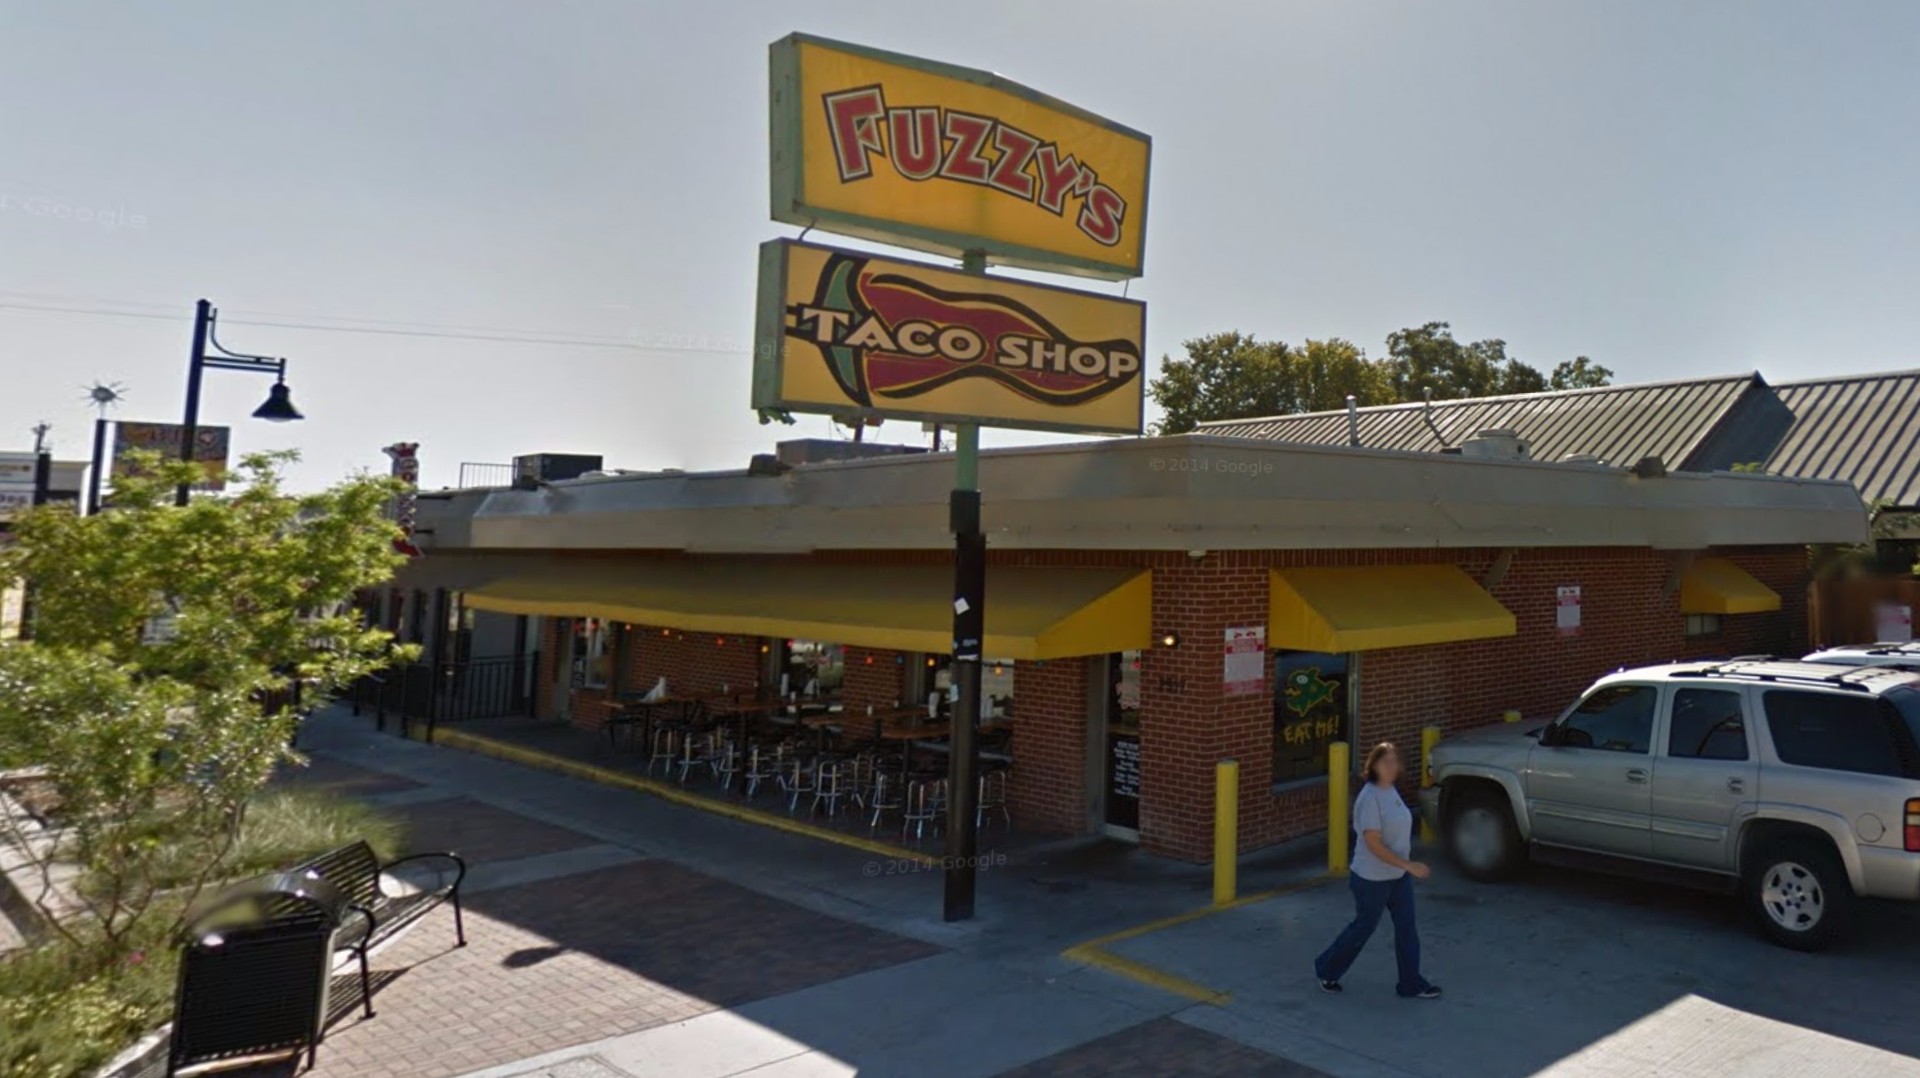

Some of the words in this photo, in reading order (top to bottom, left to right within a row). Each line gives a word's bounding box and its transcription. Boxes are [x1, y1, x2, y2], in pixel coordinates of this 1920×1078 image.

[822, 83, 1127, 247] FUZZY'S
[799, 306, 988, 361] TACO
[998, 336, 1141, 379] SHOP
[1284, 722, 1313, 744] EAT
[1315, 714, 1340, 739] ME!
